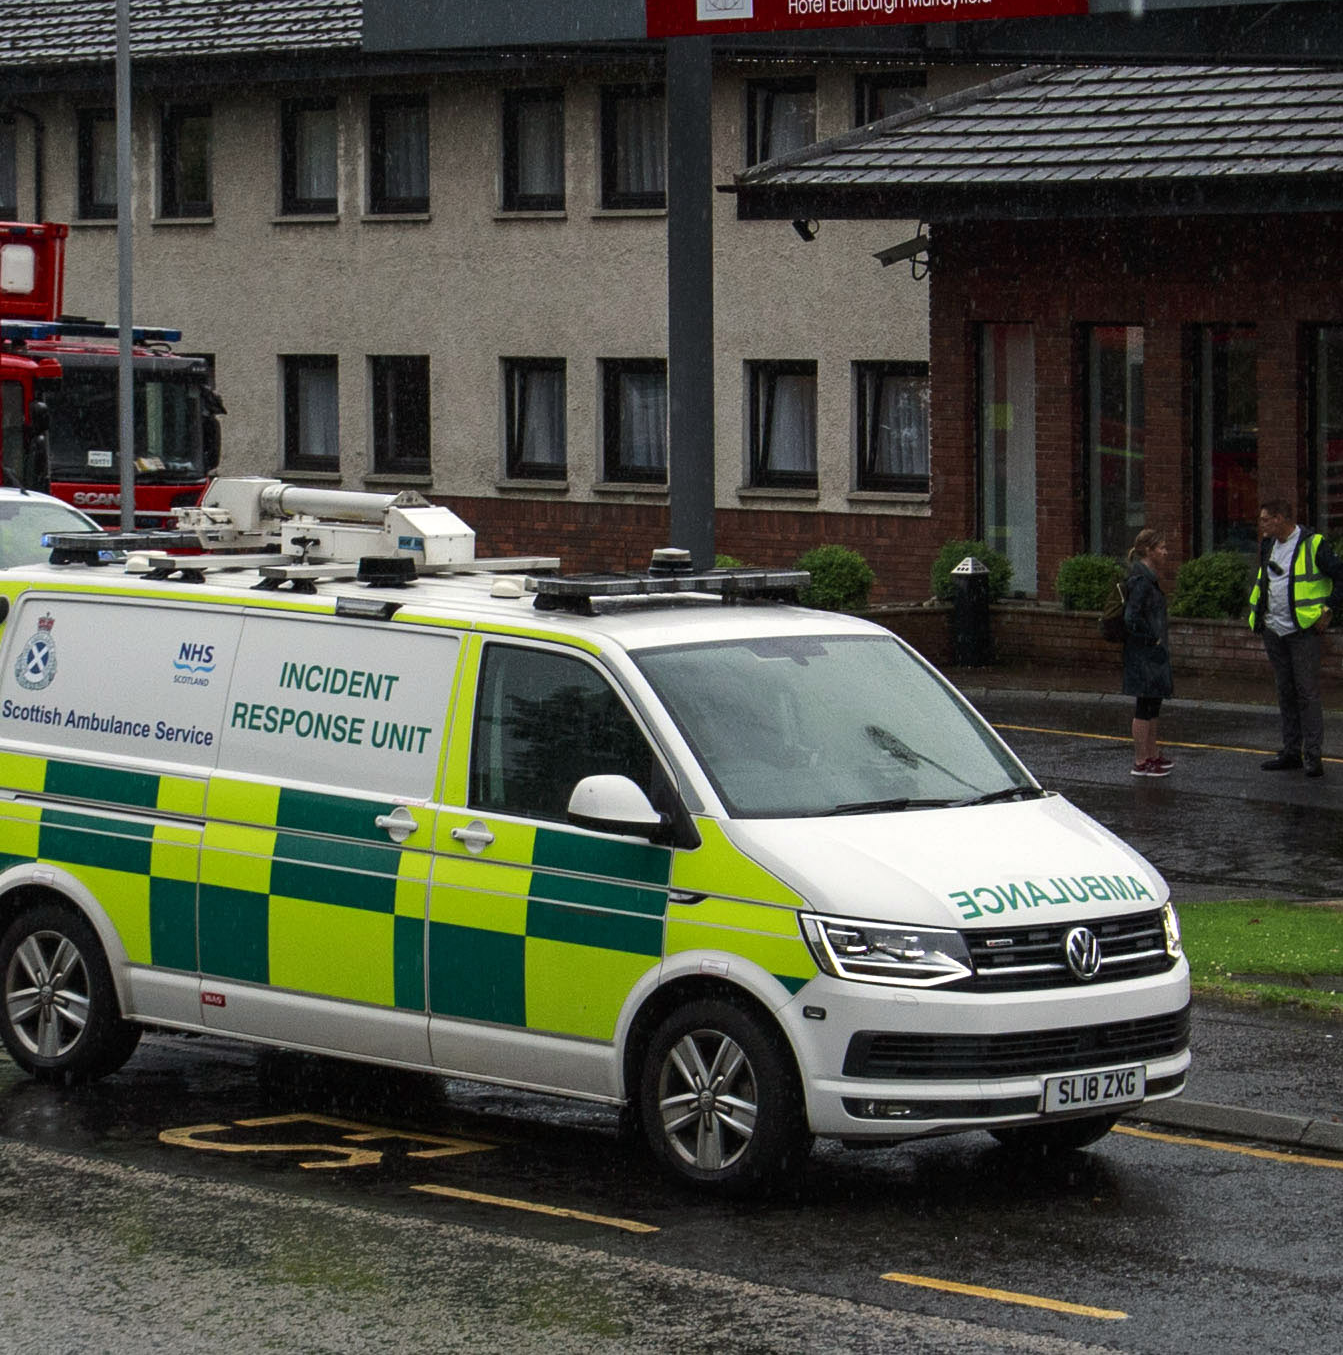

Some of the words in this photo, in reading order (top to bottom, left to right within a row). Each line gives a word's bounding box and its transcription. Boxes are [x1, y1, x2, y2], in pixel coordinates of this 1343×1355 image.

[178, 642, 215, 664] NHS
[173, 674, 210, 687] SCOTLAND
[279, 662, 400, 702] INCIDENT
[2, 699, 62, 727] Scottish
[64, 709, 150, 738] Ambulance
[154, 721, 214, 746] Service
[230, 702, 365, 745] RESPONSE
[370, 720, 433, 754] UNIT
[1058, 1076, 1099, 1105] SL18
[1103, 1070, 1136, 1099] ZXG
